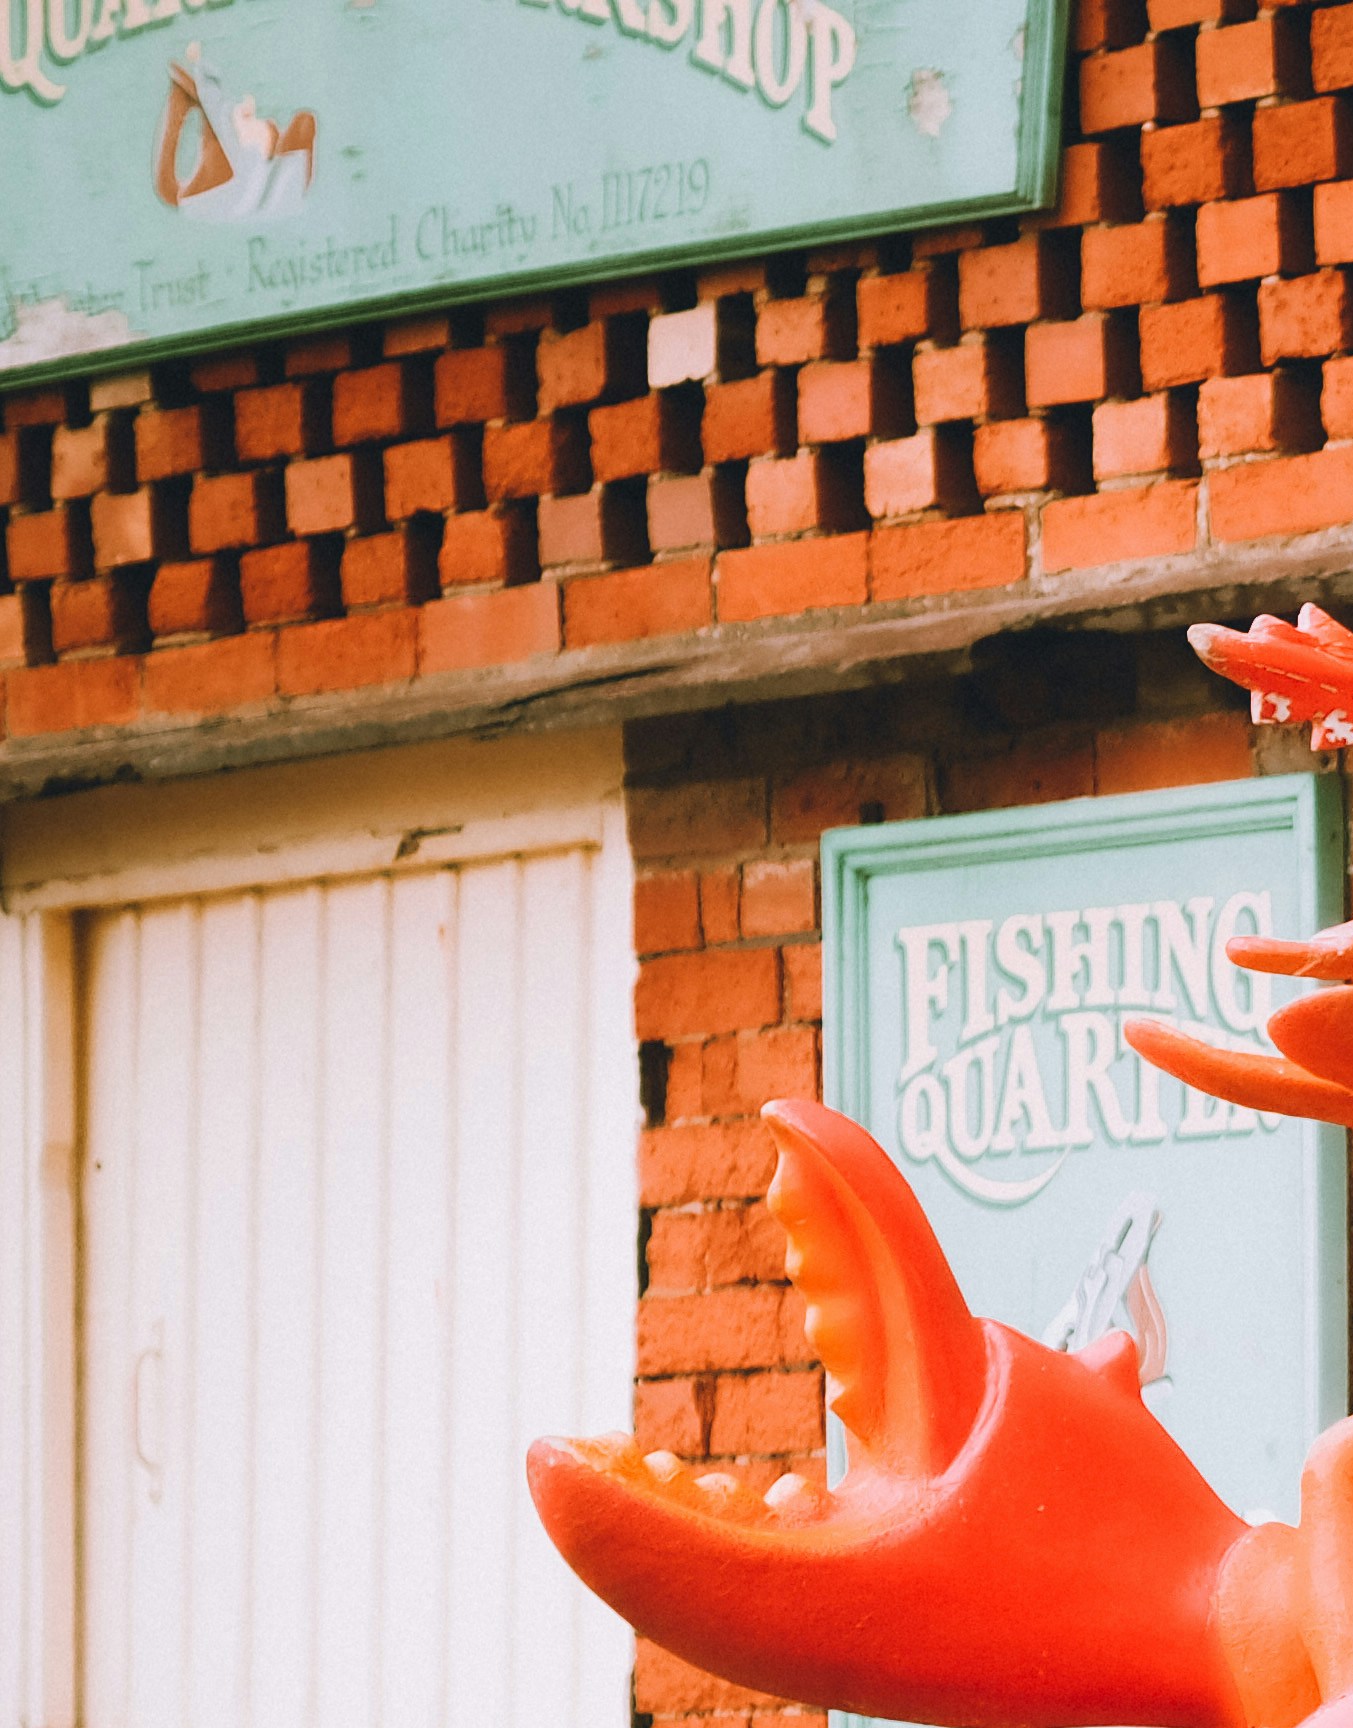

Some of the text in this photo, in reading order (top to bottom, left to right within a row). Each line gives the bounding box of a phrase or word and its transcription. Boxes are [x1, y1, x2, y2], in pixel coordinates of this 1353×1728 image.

[129, 258, 211, 314] Trust
[246, 211, 401, 307] Registered
[414, 203, 538, 263] Charity
[897, 890, 1273, 1084] FISHING
